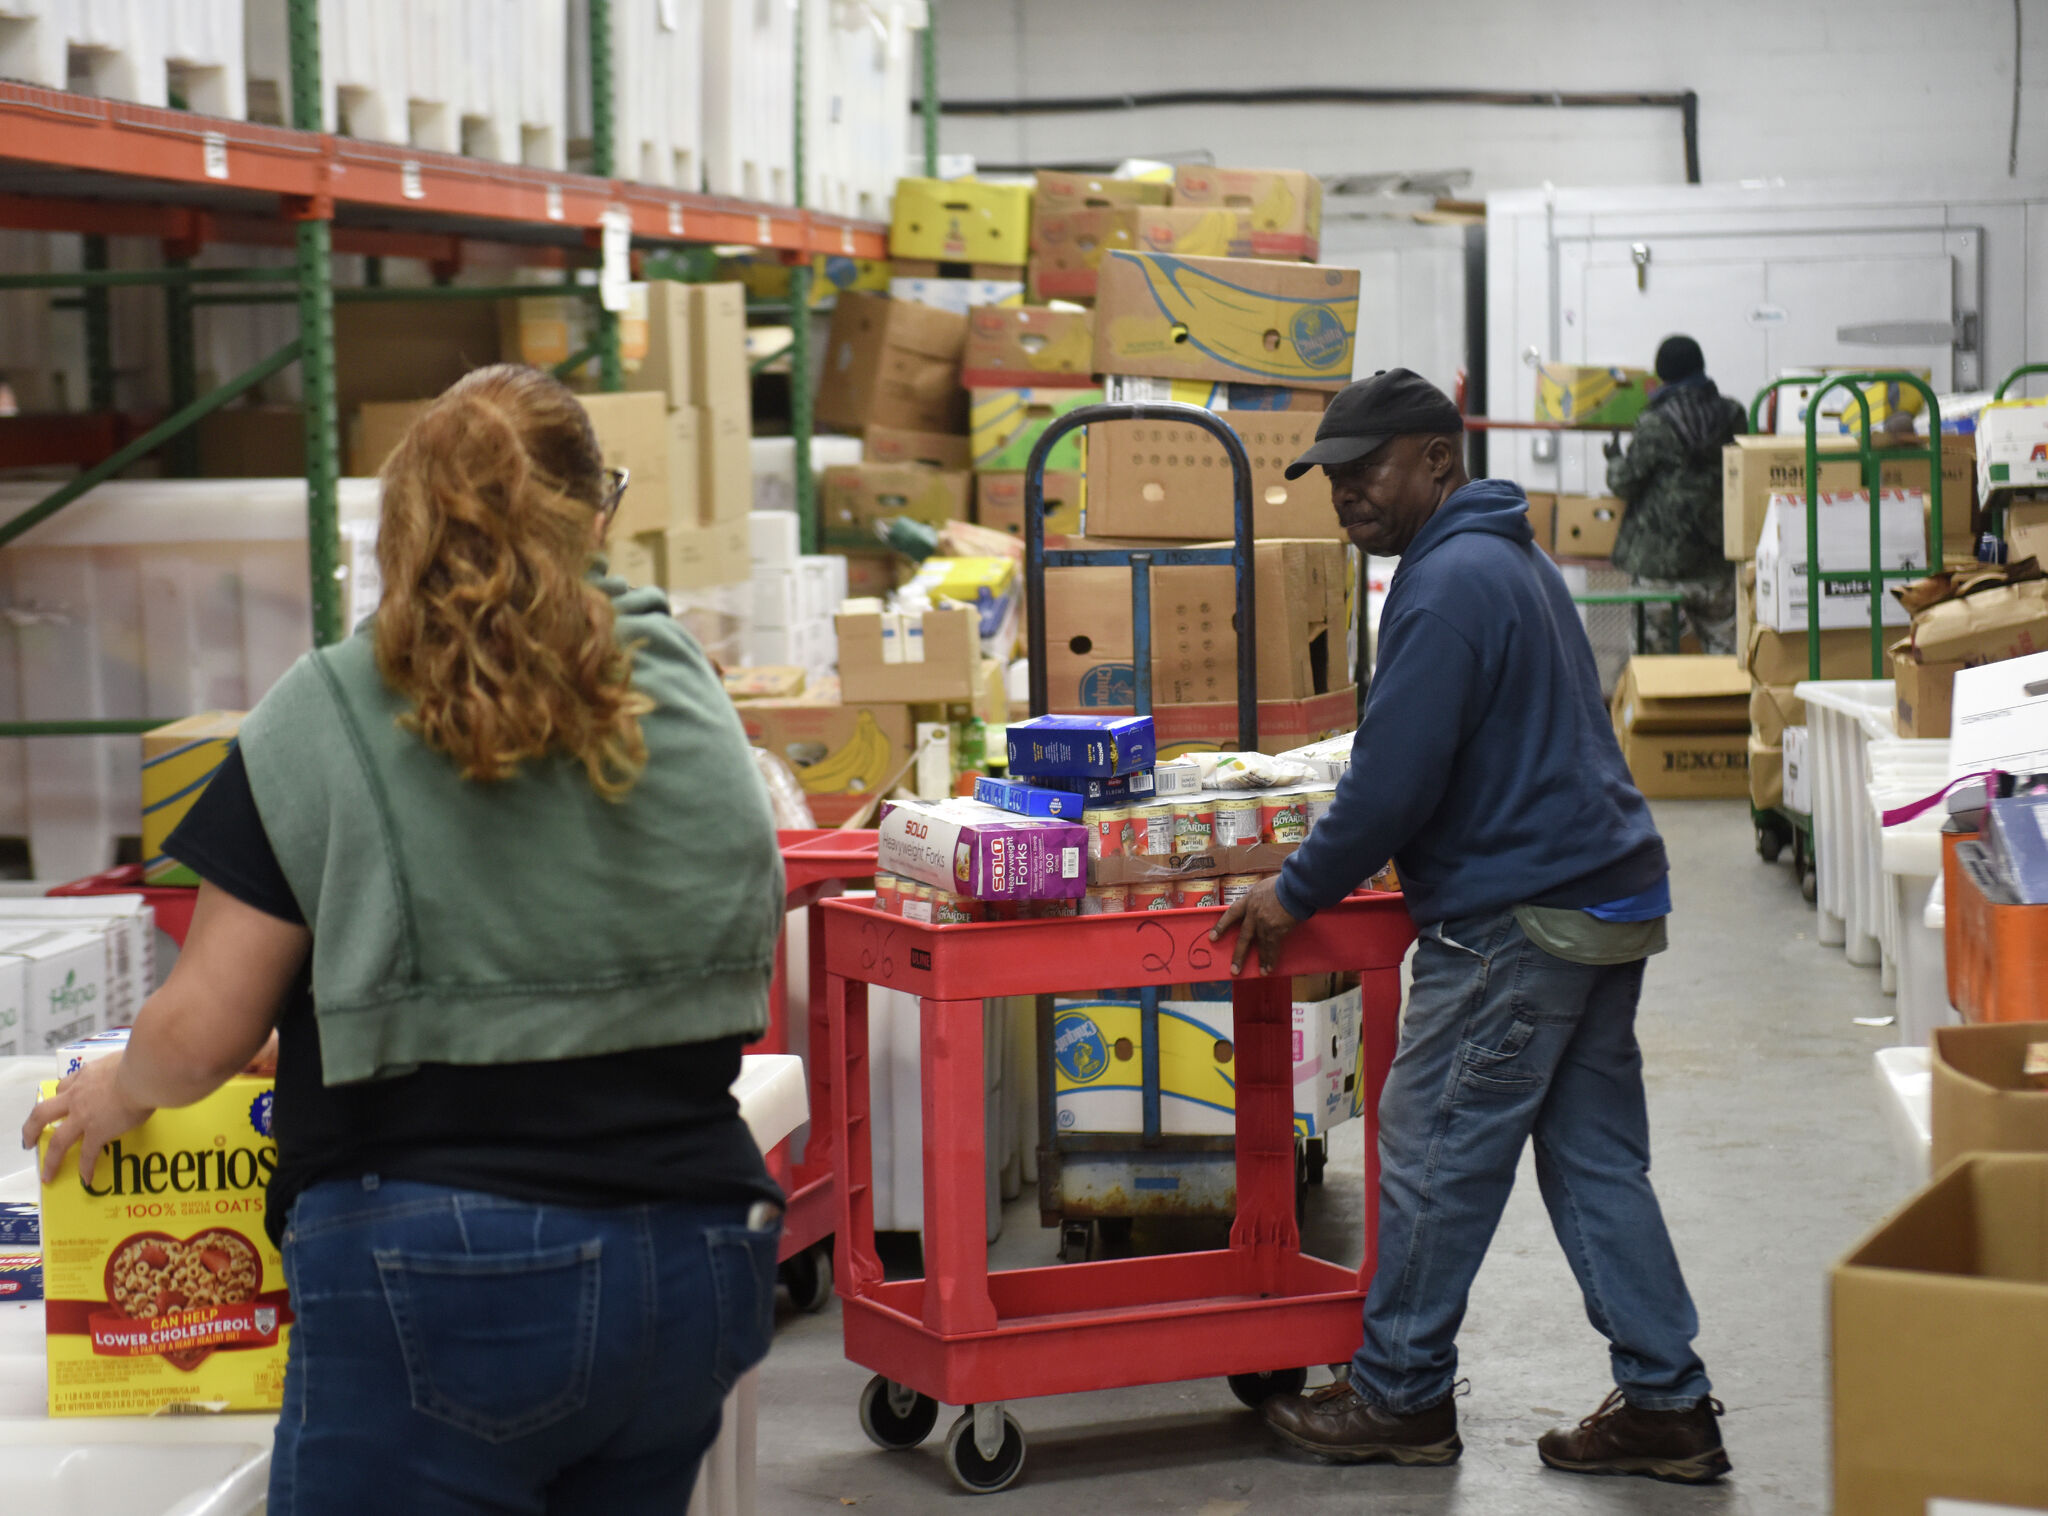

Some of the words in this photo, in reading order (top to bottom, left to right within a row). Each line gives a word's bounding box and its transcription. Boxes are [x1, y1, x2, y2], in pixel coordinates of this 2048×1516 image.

[904, 819, 929, 840] SOLO
[883, 832, 925, 862] Heavyweight
[926, 846, 945, 868] Forks
[991, 837, 1005, 892] SOLO
[1007, 836, 1015, 894] Heavyweight
[1016, 843, 1027, 886] Forks
[1046, 853, 1054, 874] 500
[862, 921, 896, 978] 26
[912, 950, 931, 968] ULINE
[1136, 920, 1213, 974] 26
[80, 1135, 278, 1197] Cheerios
[125, 1203, 176, 1217] 100%
[215, 1199, 263, 1214] OATS
[96, 1332, 147, 1347] LOWER
[150, 1318, 251, 1343] CHOLESTEROL
[151, 1316, 179, 1330] CAN
[183, 1309, 219, 1324] HELP
[140, 1344, 156, 1354] PART
[175, 1338, 195, 1350] HEART
[197, 1333, 224, 1346] HEALTHY
[225, 1331, 241, 1342] DIET
